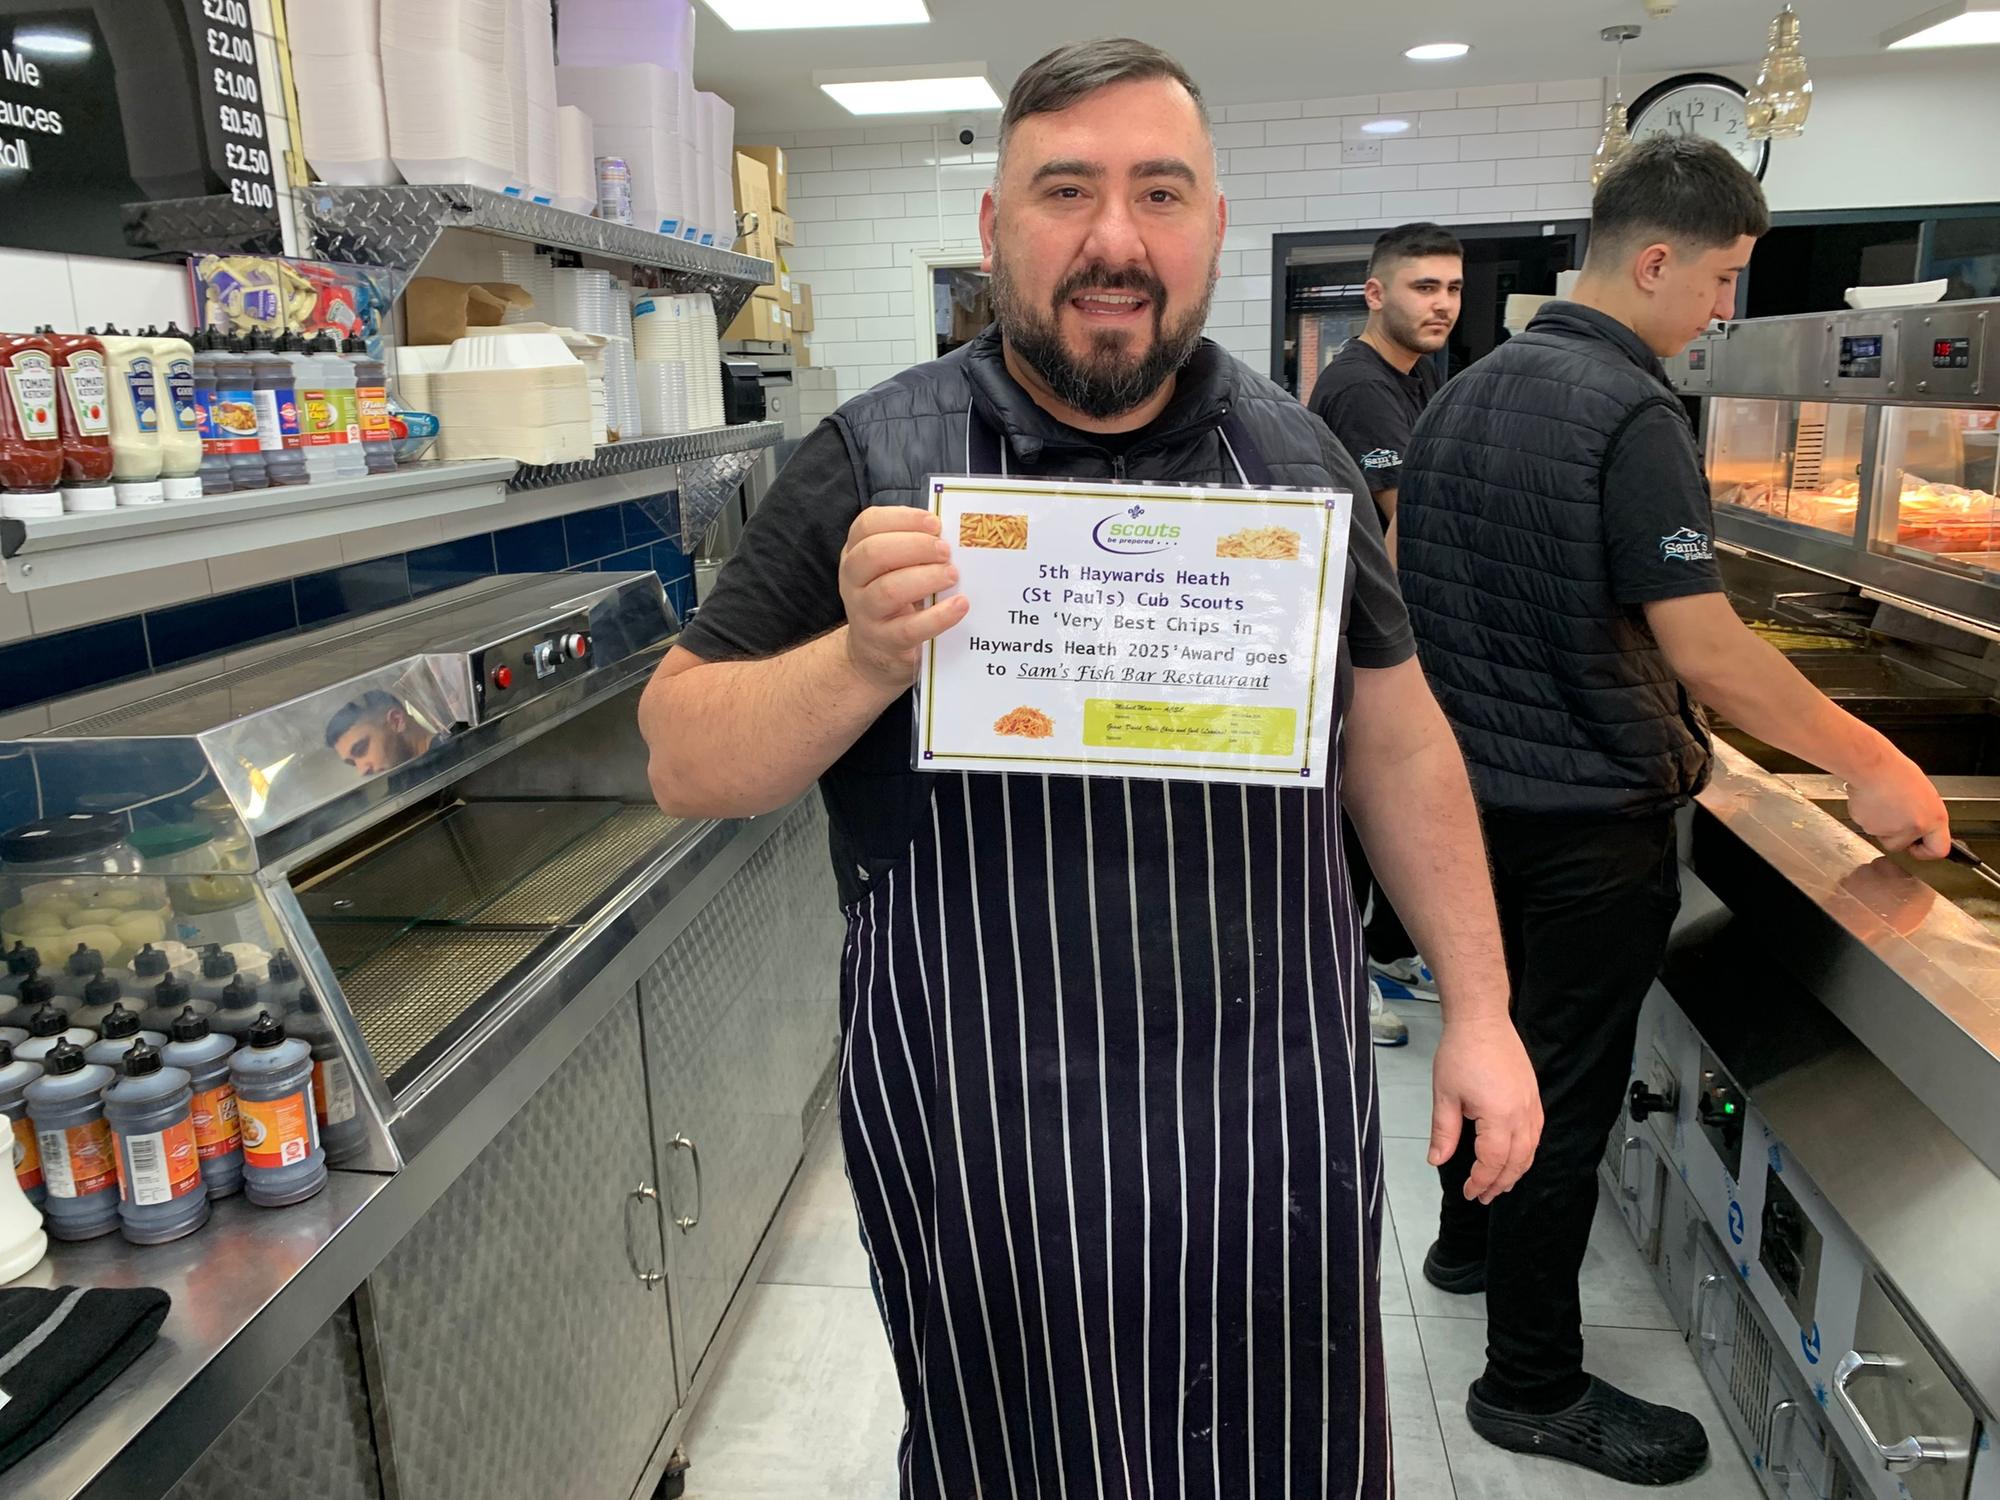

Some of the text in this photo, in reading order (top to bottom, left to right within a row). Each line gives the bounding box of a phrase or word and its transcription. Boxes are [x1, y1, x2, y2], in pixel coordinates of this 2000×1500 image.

[203, 0, 247, 28] £2.00
[207, 28, 253, 65] £2.00
[2, 49, 40, 87] Me
[214, 67, 257, 103] £1.00
[220, 105, 262, 138] £0.50
[1686, 102, 1705, 118] 12
[1713, 106, 1720, 122] 1
[1725, 119, 1737, 134] 2
[225, 143, 269, 175] £2.50
[231, 178, 272, 209] £1.00
[1110, 523, 1181, 538] scouts
[1664, 540, 1708, 554] Sam's
[1038, 564, 1230, 586] 5th Haywards Heath
[1022, 587, 1244, 611] (St Pauls) Cub Scouts
[1008, 610, 1252, 636] The 'Very Best Chips in
[969, 636, 1053, 654] Haywards
[1065, 640, 1117, 656] Heath
[1245, 651, 1288, 666] goes
[987, 662, 1271, 688] to Sam's Fish Bar Restaurant
